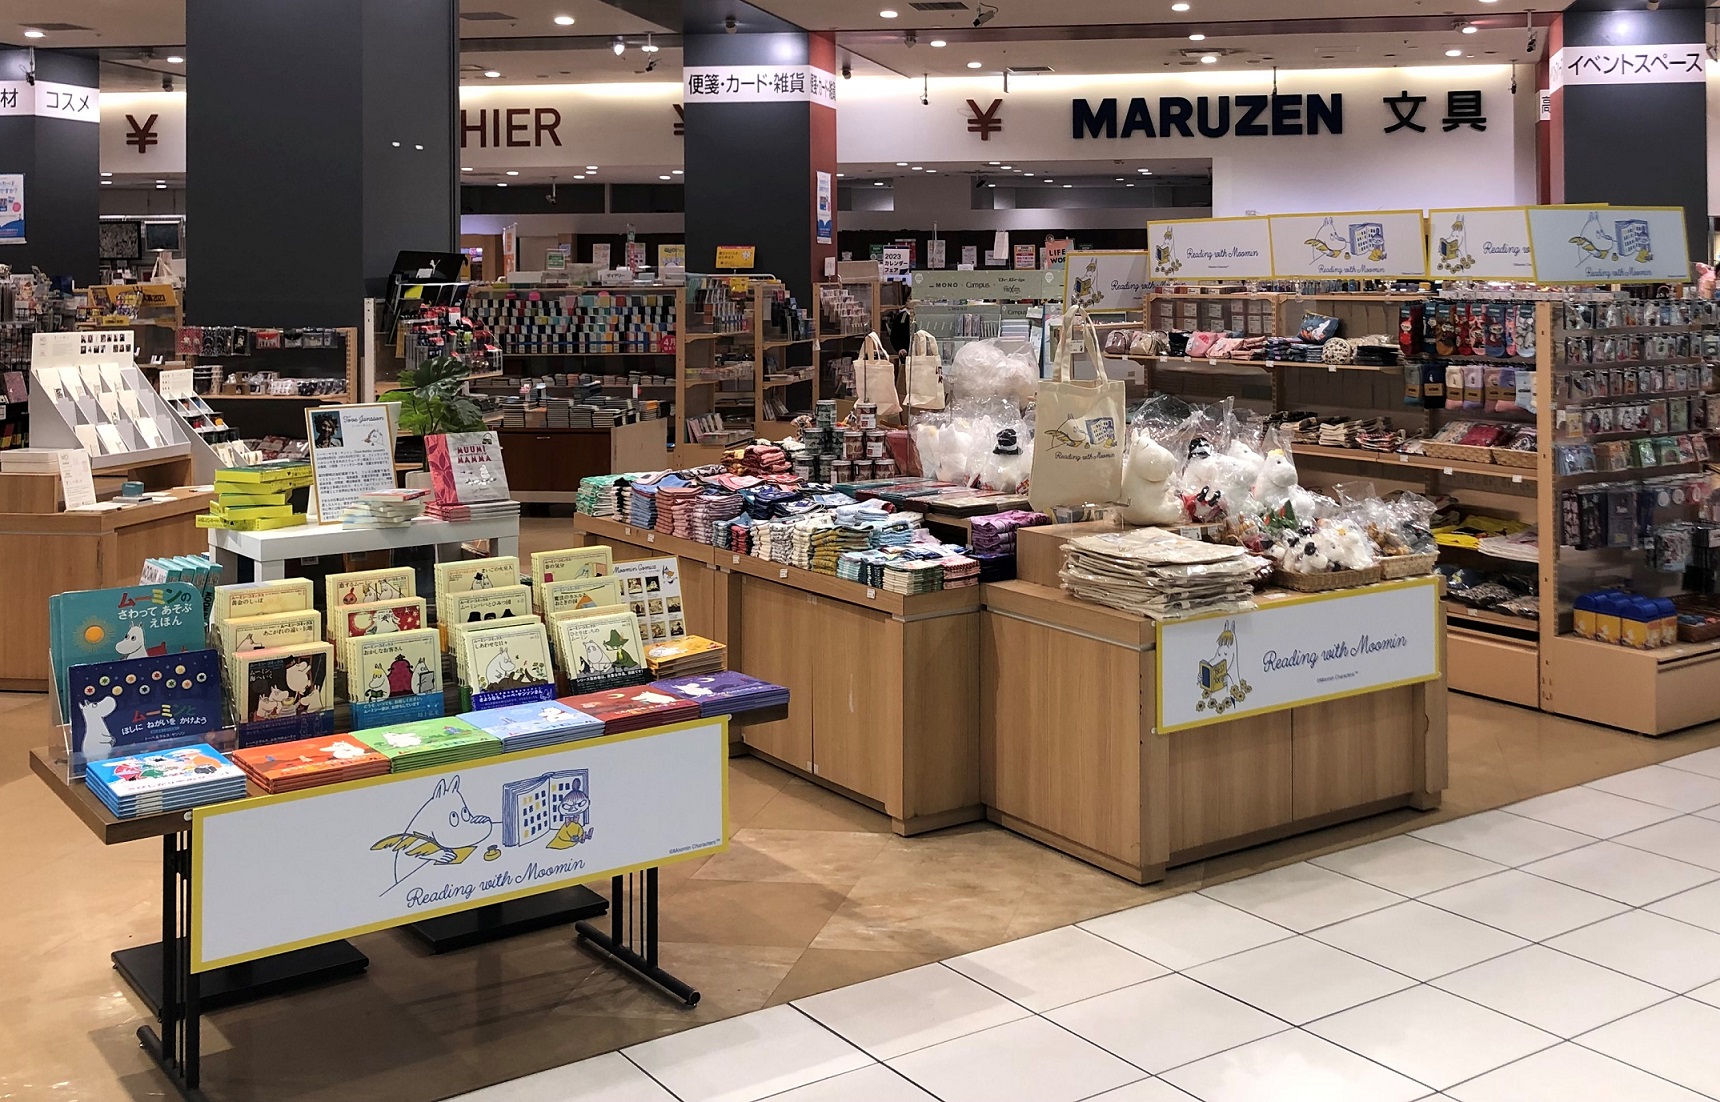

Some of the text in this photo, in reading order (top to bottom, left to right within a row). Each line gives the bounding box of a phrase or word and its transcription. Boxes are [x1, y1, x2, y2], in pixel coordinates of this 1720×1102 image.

[1568, 53, 1703, 76] イベントスペース
[688, 72, 805, 95] 便箋・カード・雑貨
[0, 87, 19, 109] 材
[46, 90, 90, 113] コスメ
[1072, 93, 1343, 139] MARUZEN
[1049, 248, 1066, 257] LIFE
[1186, 246, 1259, 262] Reading with Moomin
[1483, 241, 1520, 257] Reading
[1318, 263, 1385, 275] Reading with Moomin
[1585, 266, 1653, 279] Reading with Moomin
[965, 281, 990, 289] Campus
[1110, 279, 1139, 292] Reading
[1055, 451, 1081, 462] Reading
[117, 588, 192, 609] ムーミンの
[117, 603, 193, 620] さわって あそぶ
[149, 615, 183, 629] えほん
[1262, 633, 1408, 673] Reading with Moomin
[132, 703, 197, 723] ムーミンと
[121, 723, 144, 736] ほしに
[146, 717, 176, 730] ねがいを
[179, 716, 208, 725] かけよう
[406, 857, 586, 909] Reading with Moomin
